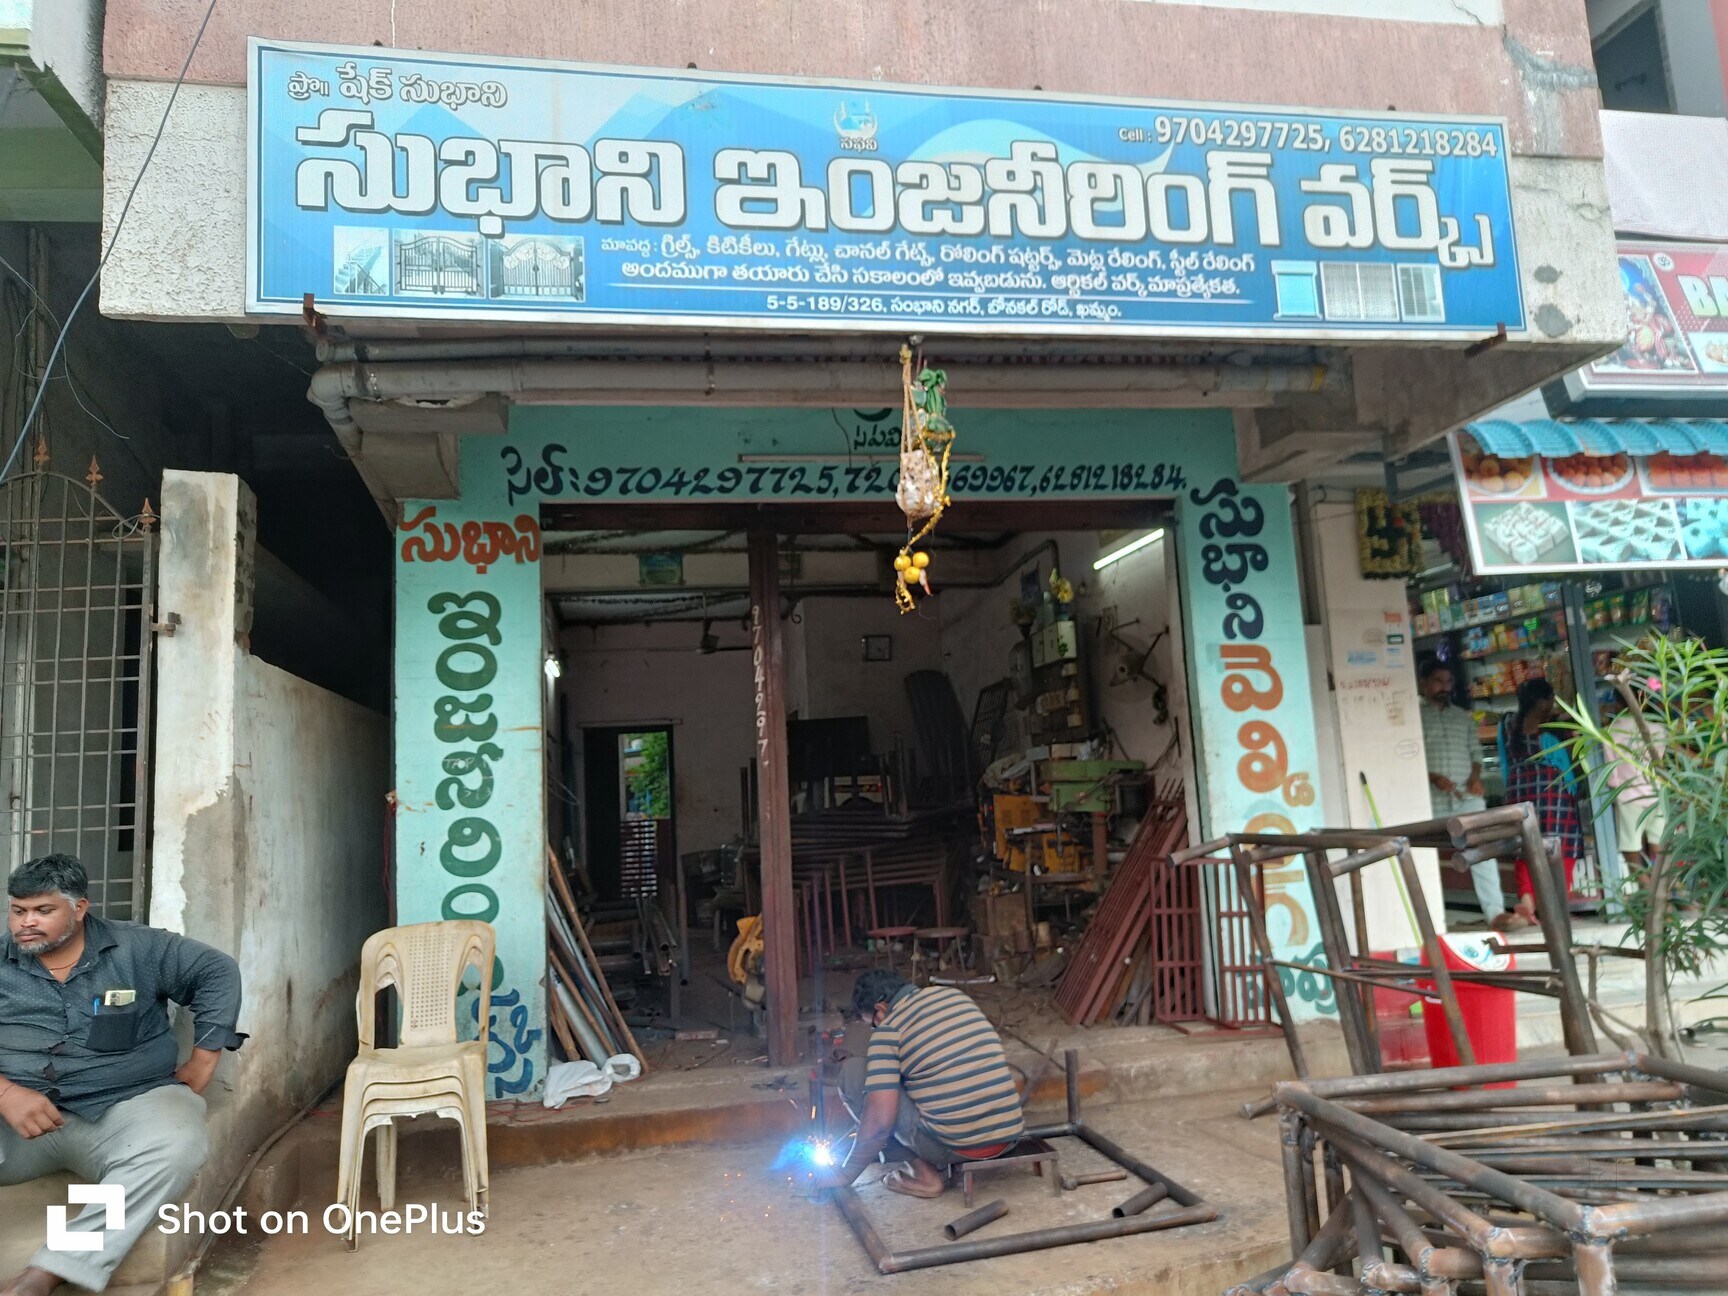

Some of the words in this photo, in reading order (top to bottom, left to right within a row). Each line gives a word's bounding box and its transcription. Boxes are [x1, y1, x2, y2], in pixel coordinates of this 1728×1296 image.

[335, 61, 393, 105] షేక్
[399, 74, 508, 110] సుభాని
[1118, 128, 1143, 143] Cell
[1154, 116, 1331, 152] 9704297725,
[1339, 125, 1497, 158] 6281218284
[295, 108, 688, 238] సుభాని
[714, 141, 1281, 247] ఇంజనీరింగ్
[732, 263, 810, 283] తయారు
[852, 266, 944, 286] సకాలంలో
[834, 240, 891, 260] చానల్
[940, 243, 1005, 264] రోలింగ్
[1202, 250, 1255, 272] రేలింగ్
[766, 294, 887, 313] 5-5-189/326,
[400, 505, 540, 575] సుభాని
[1190, 477, 1269, 640] సుభాని
